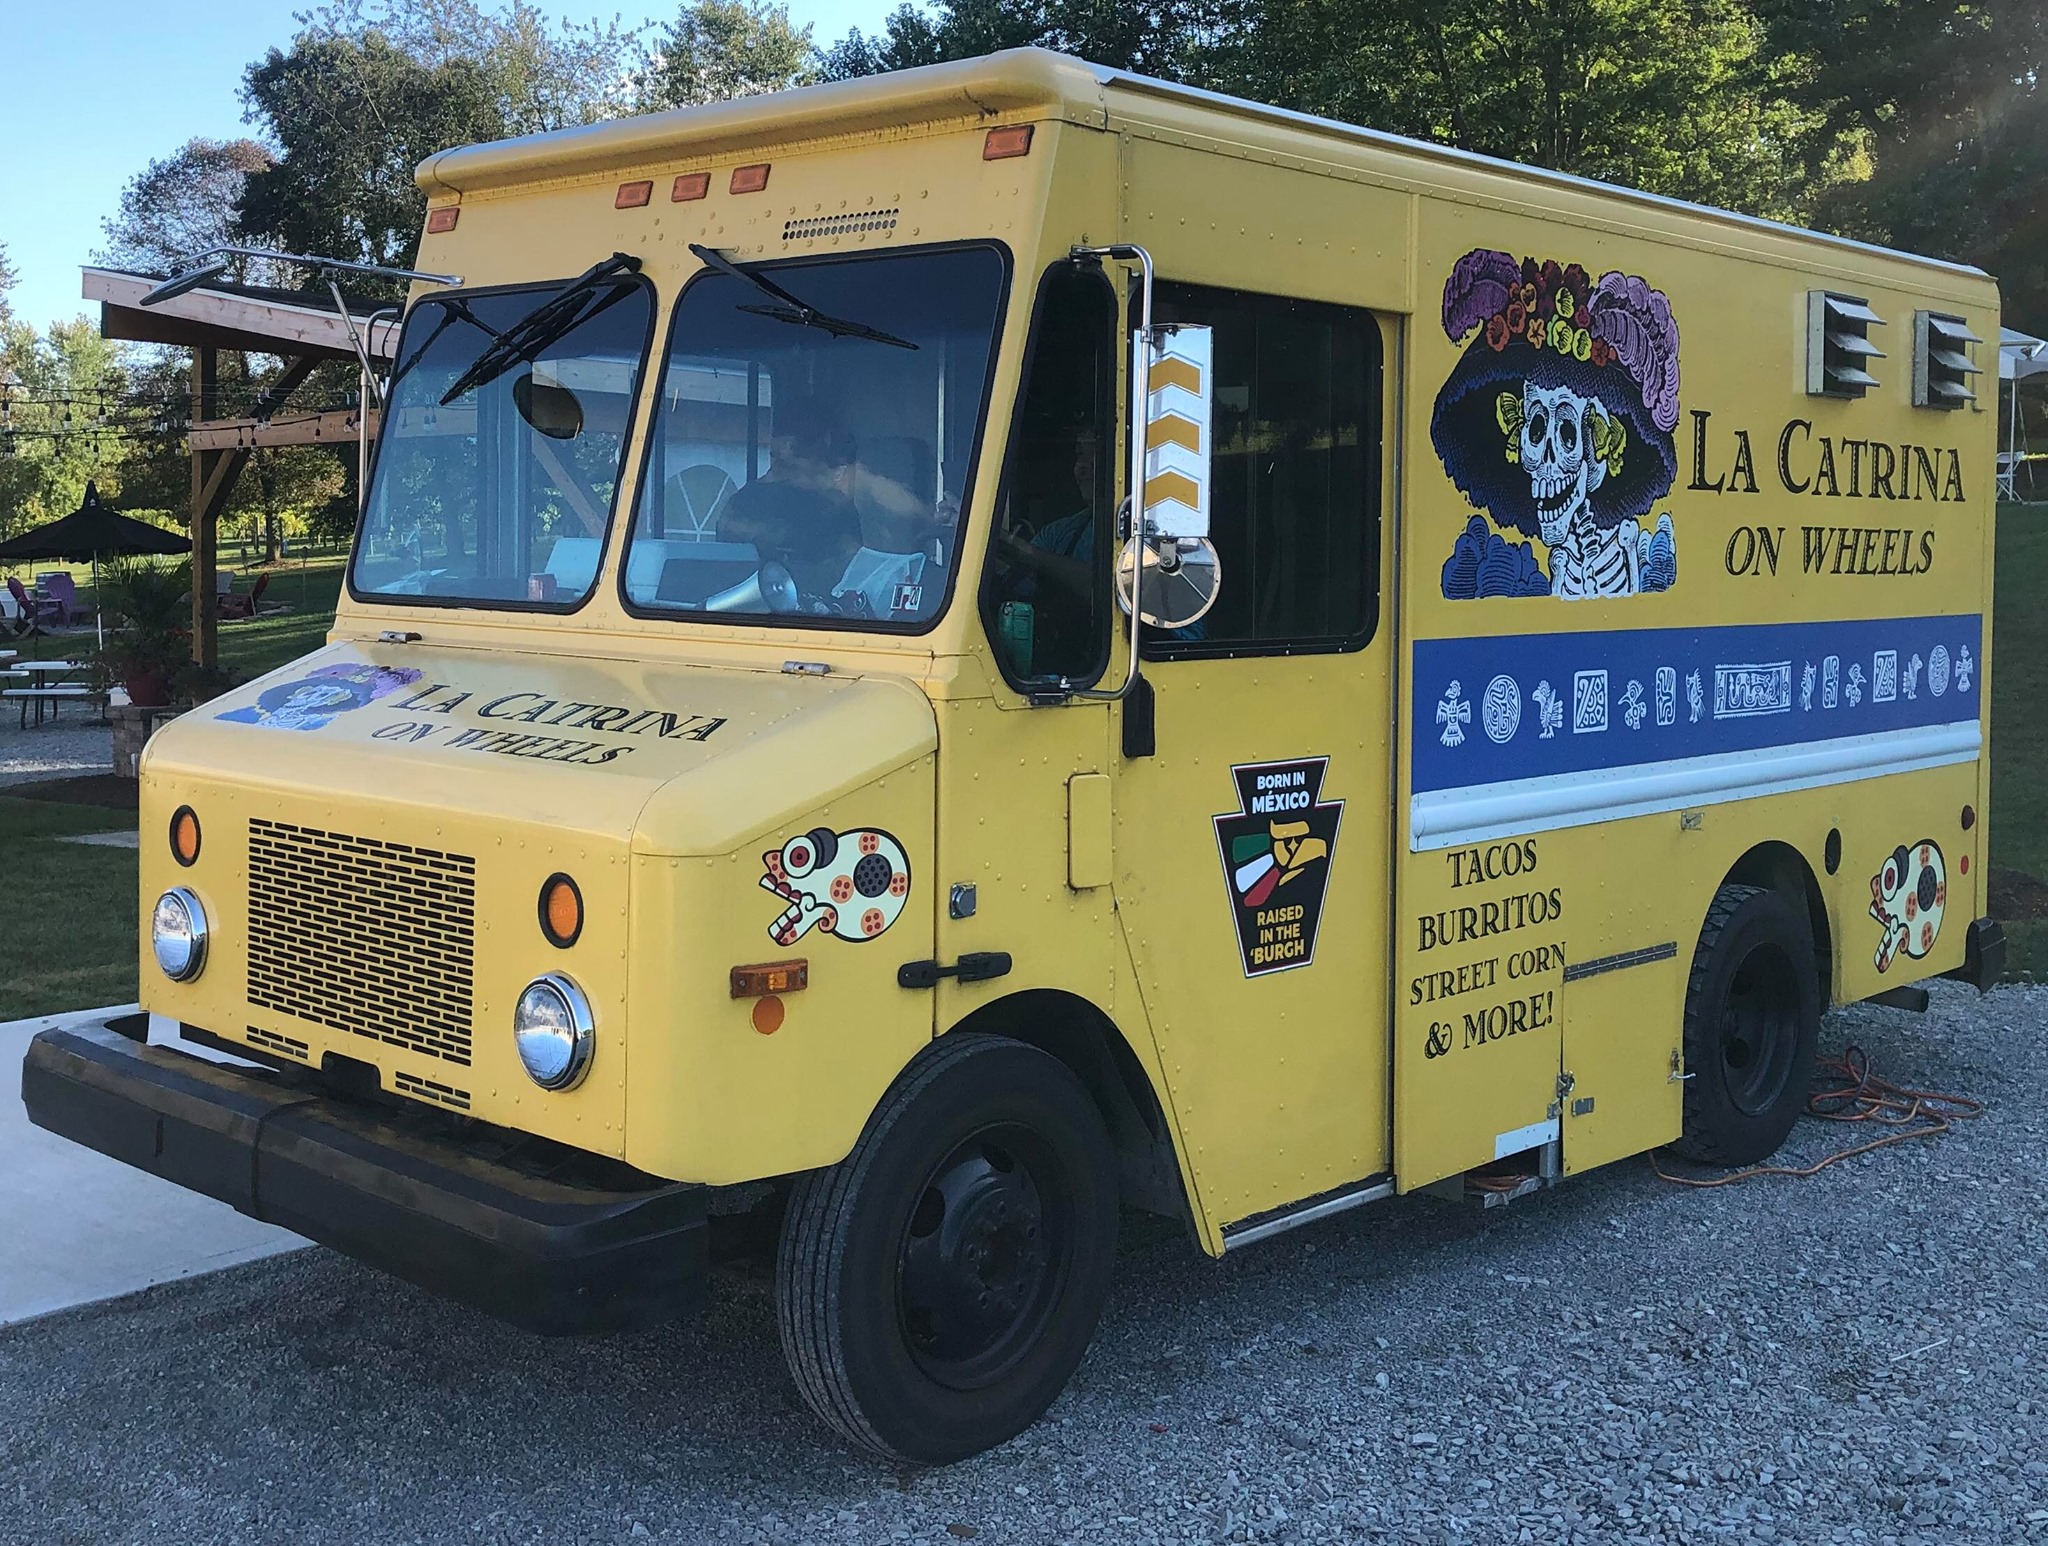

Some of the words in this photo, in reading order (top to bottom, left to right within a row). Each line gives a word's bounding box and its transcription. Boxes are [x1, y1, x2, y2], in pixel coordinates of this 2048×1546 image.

[1725, 526, 1786, 576] ON
[1801, 526, 1935, 576] WHEELS
[370, 721, 449, 743] ON
[442, 727, 637, 766] WHEELS
[1252, 790, 1310, 814] MÉXICO
[1257, 774, 1291, 790] BORN
[1292, 771, 1306, 786] IN
[1447, 838, 1537, 888] TACOS
[1257, 904, 1303, 927] RAISED
[1260, 928, 1274, 944] IN
[1276, 923, 1301, 941] THE
[1417, 887, 1562, 951] BURRITOS
[1409, 957, 1499, 1006] STREET
[1507, 942, 1567, 979] CORN
[1424, 1022, 1453, 1059] &
[1462, 990, 1553, 1050] MORE!
